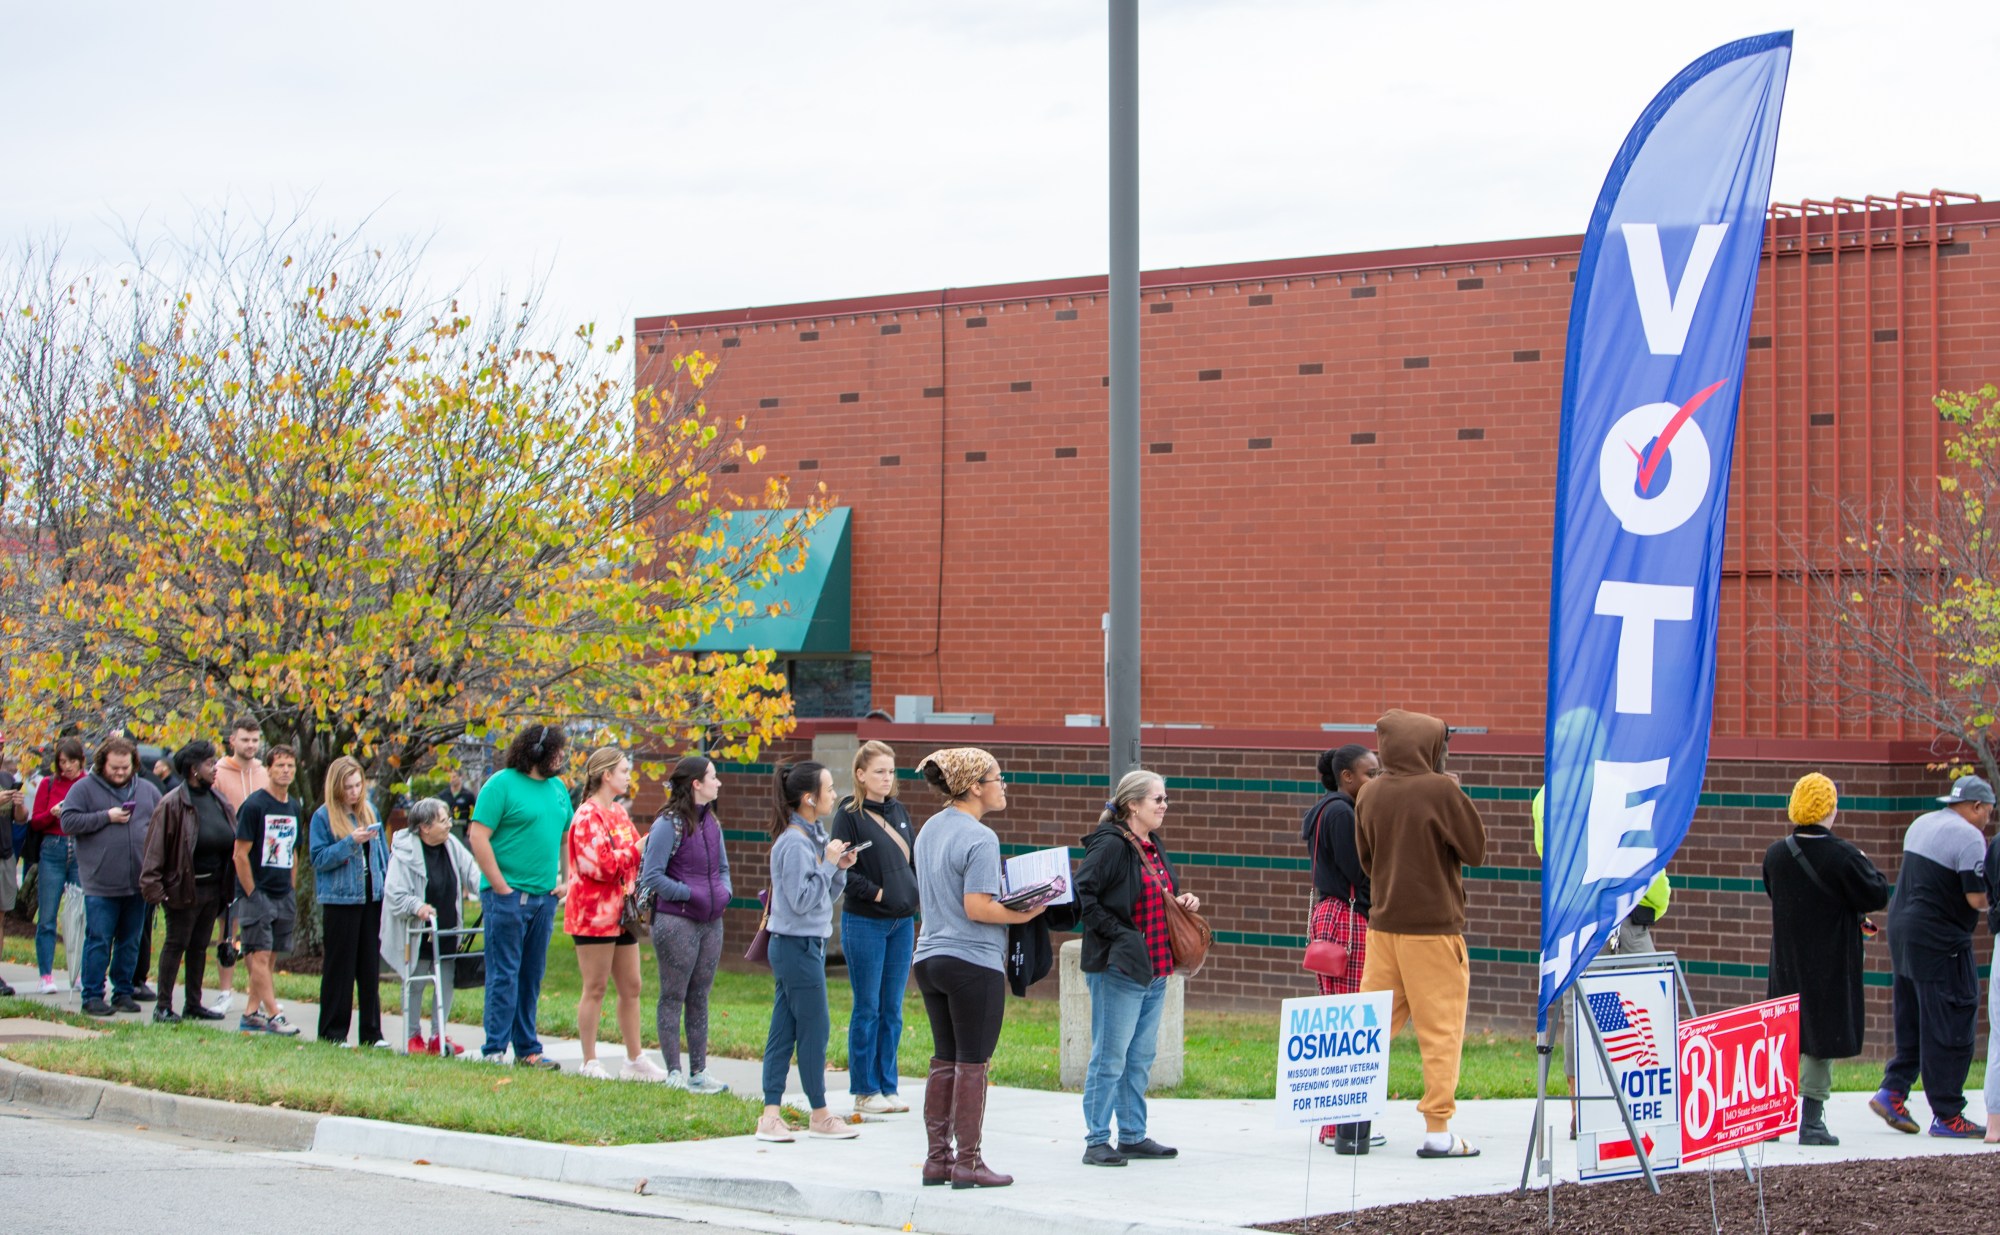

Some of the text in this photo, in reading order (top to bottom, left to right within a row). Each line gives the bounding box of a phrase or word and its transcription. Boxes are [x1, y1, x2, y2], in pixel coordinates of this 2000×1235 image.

[1581, 223, 1729, 885] VOTE
[1290, 1004, 1356, 1034] MARK
[1680, 1023, 1718, 1040] Derron
[1287, 1029, 1381, 1061] OSMACK
[1288, 1062, 1379, 1079] MISSOURI COMBAT VETERAN
[1331, 1078, 1349, 1088] YOUR
[1681, 1033, 1787, 1140] BLACK
[1293, 1091, 1368, 1111] FOR TREASURER
[1725, 1110, 1737, 1121] MO
[1737, 1105, 1751, 1117] State
[1751, 1101, 1769, 1114] Senate
[1782, 1096, 1788, 1106] 9
[1729, 1125, 1745, 1138] NOT
